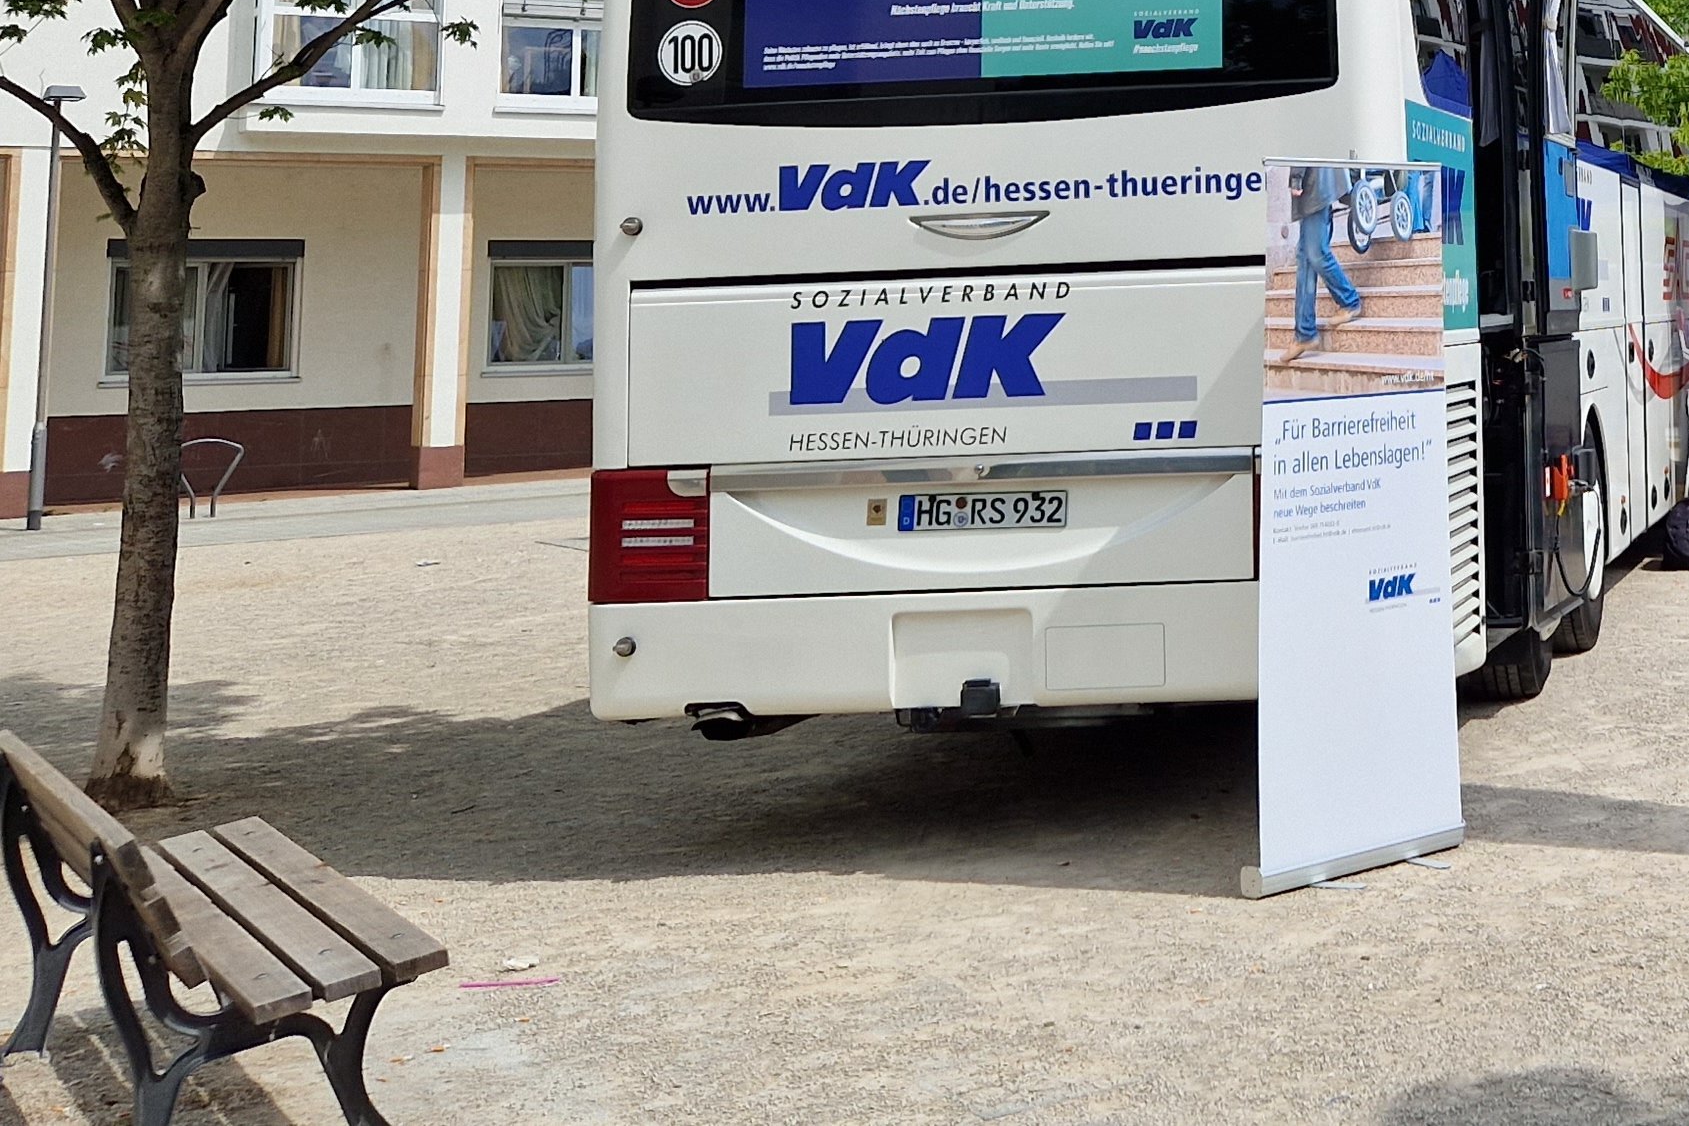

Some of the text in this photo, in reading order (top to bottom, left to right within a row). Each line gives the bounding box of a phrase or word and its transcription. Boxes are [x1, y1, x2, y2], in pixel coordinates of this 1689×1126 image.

[1134, 18, 1198, 39] VdK
[668, 33, 713, 74] 100
[1412, 119, 1466, 153] SOZIALVERBAND
[687, 159, 1267, 215] www.VdK.de/hessen-thueringe
[790, 282, 1071, 309] SOZIALVERBAND
[789, 313, 1066, 405] VdK
[788, 426, 1008, 452] HESSEN-THÜRINGEN
[1275, 410, 1416, 445] „Für Barrierefreiheit
[1273, 454, 1286, 475] in
[1292, 450, 1328, 474] allen
[1274, 478, 1381, 500] Mit dem Sozialverband VdK
[916, 499, 952, 526] HG
[971, 497, 1006, 525] RS
[1013, 496, 1064, 524] 932
[1273, 499, 1366, 519] neue Wege beschreiten
[1369, 573, 1416, 602] VdK
